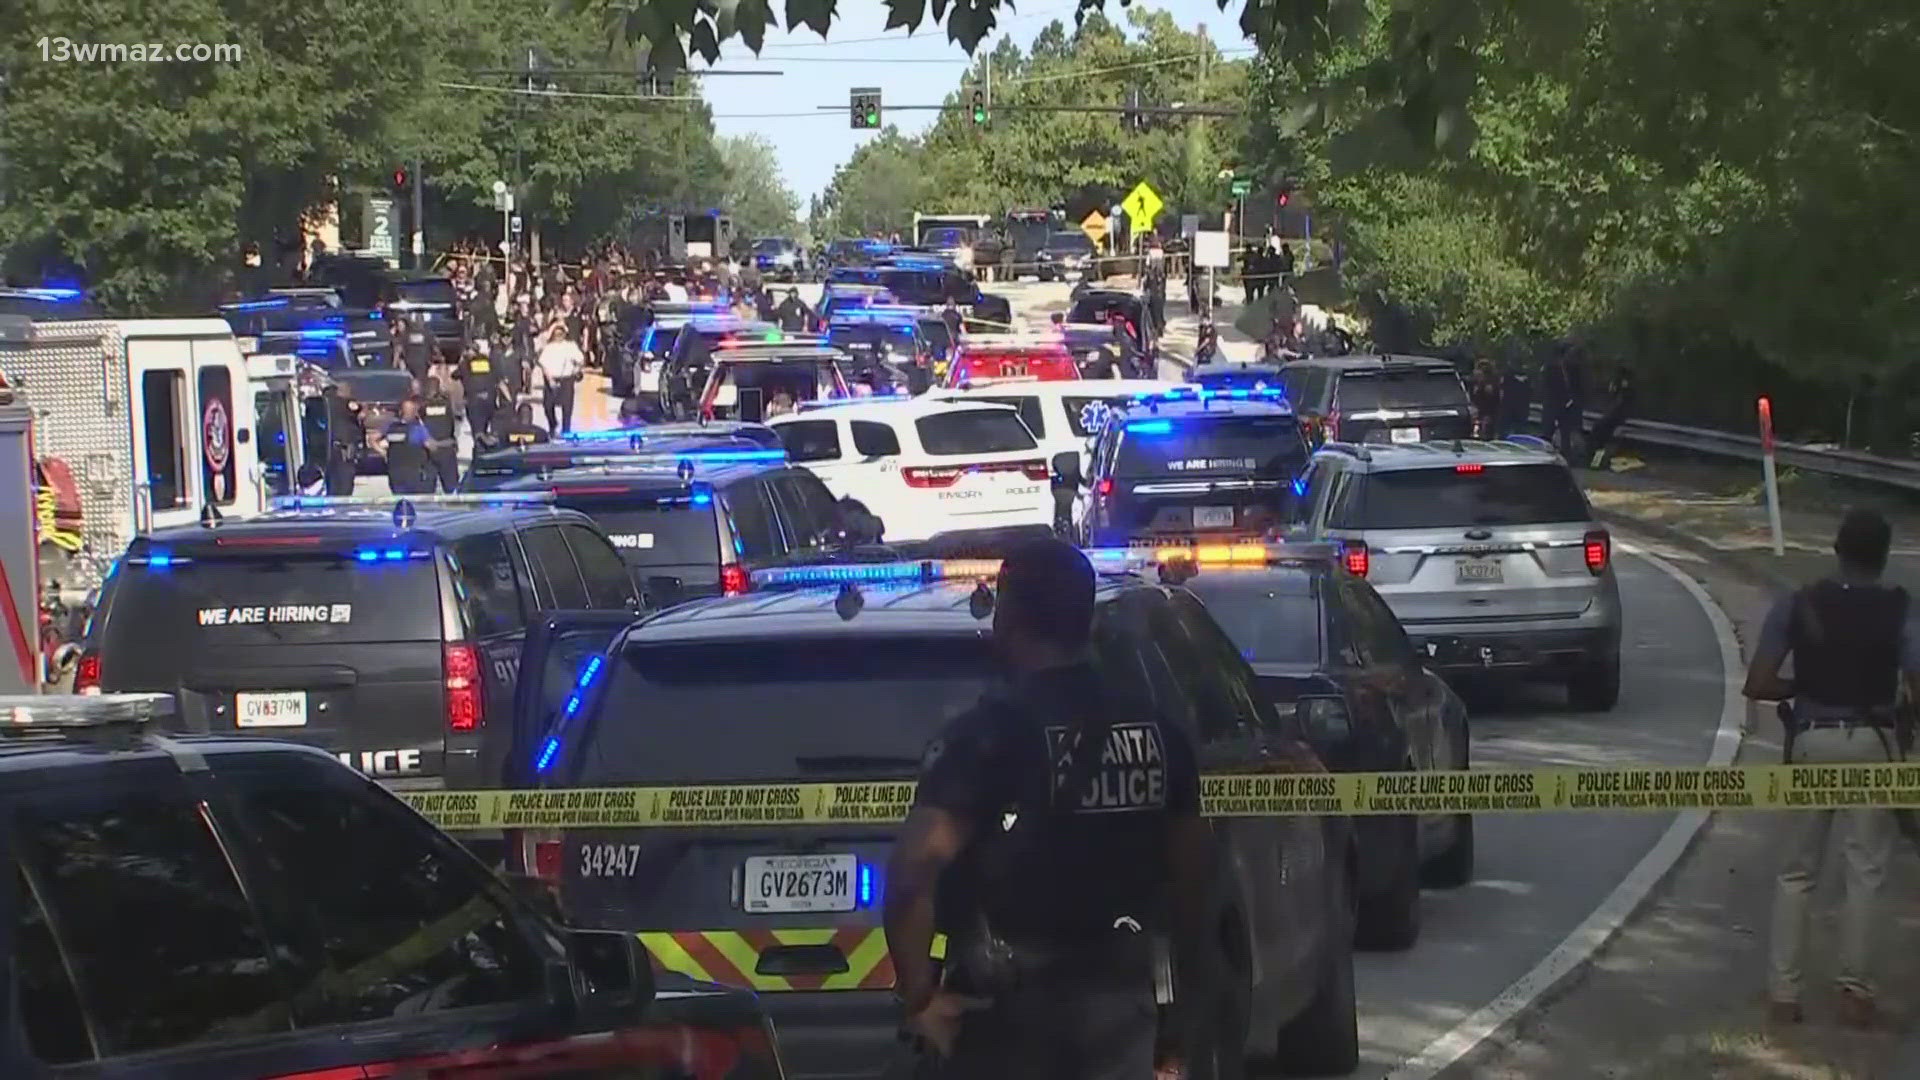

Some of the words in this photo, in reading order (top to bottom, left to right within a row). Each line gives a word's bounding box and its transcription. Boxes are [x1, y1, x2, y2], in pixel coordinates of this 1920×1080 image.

[374, 216, 389, 235] 2
[1167, 461, 1183, 470] WE
[1186, 459, 1207, 469] ARE
[938, 491, 983, 500] EMORY
[1005, 486, 1041, 495] POLICE
[199, 609, 227, 625] WE
[229, 607, 266, 624] ARE
[269, 605, 328, 623] HIRING
[247, 700, 301, 717] GV8379M
[1058, 769, 1163, 807] OLICE
[1200, 778, 1225, 797] LICE
[1228, 778, 1252, 797] LINE
[1255, 778, 1271, 797] DO
[1274, 778, 1296, 797] NOT
[1299, 777, 1336, 796] CROSS
[1376, 775, 1417, 794] POLICE
[1420, 775, 1445, 794] LINE
[1449, 775, 1465, 794] DO
[1468, 774, 1491, 793] NOT
[1494, 774, 1534, 793] CROSS
[1577, 772, 1620, 791] POLICE
[1623, 771, 1650, 791] LINE
[1654, 771, 1671, 790] DO
[1675, 771, 1700, 790] NOT
[1703, 770, 1745, 790] CROSS
[1792, 768, 1838, 788] POLICE
[1842, 768, 1870, 787] LINE
[1874, 768, 1893, 787] DO
[425, 795, 446, 811] NOT
[446, 794, 478, 811] CROSS
[509, 792, 545, 810] POLICE
[545, 792, 566, 809] LINE
[568, 792, 582, 809] DO
[583, 791, 603, 809] NOT
[603, 791, 637, 809] CROSS
[669, 789, 703, 808] POLICE
[705, 789, 728, 806] LINE
[729, 788, 744, 806] DO
[745, 788, 766, 806] NOT
[766, 787, 800, 805] CROSS
[835, 786, 869, 804] POLICE
[871, 785, 895, 804] LINE
[896, 785, 912, 803] DO
[581, 844, 640, 876] 34247
[760, 870, 848, 898] GV2673M
